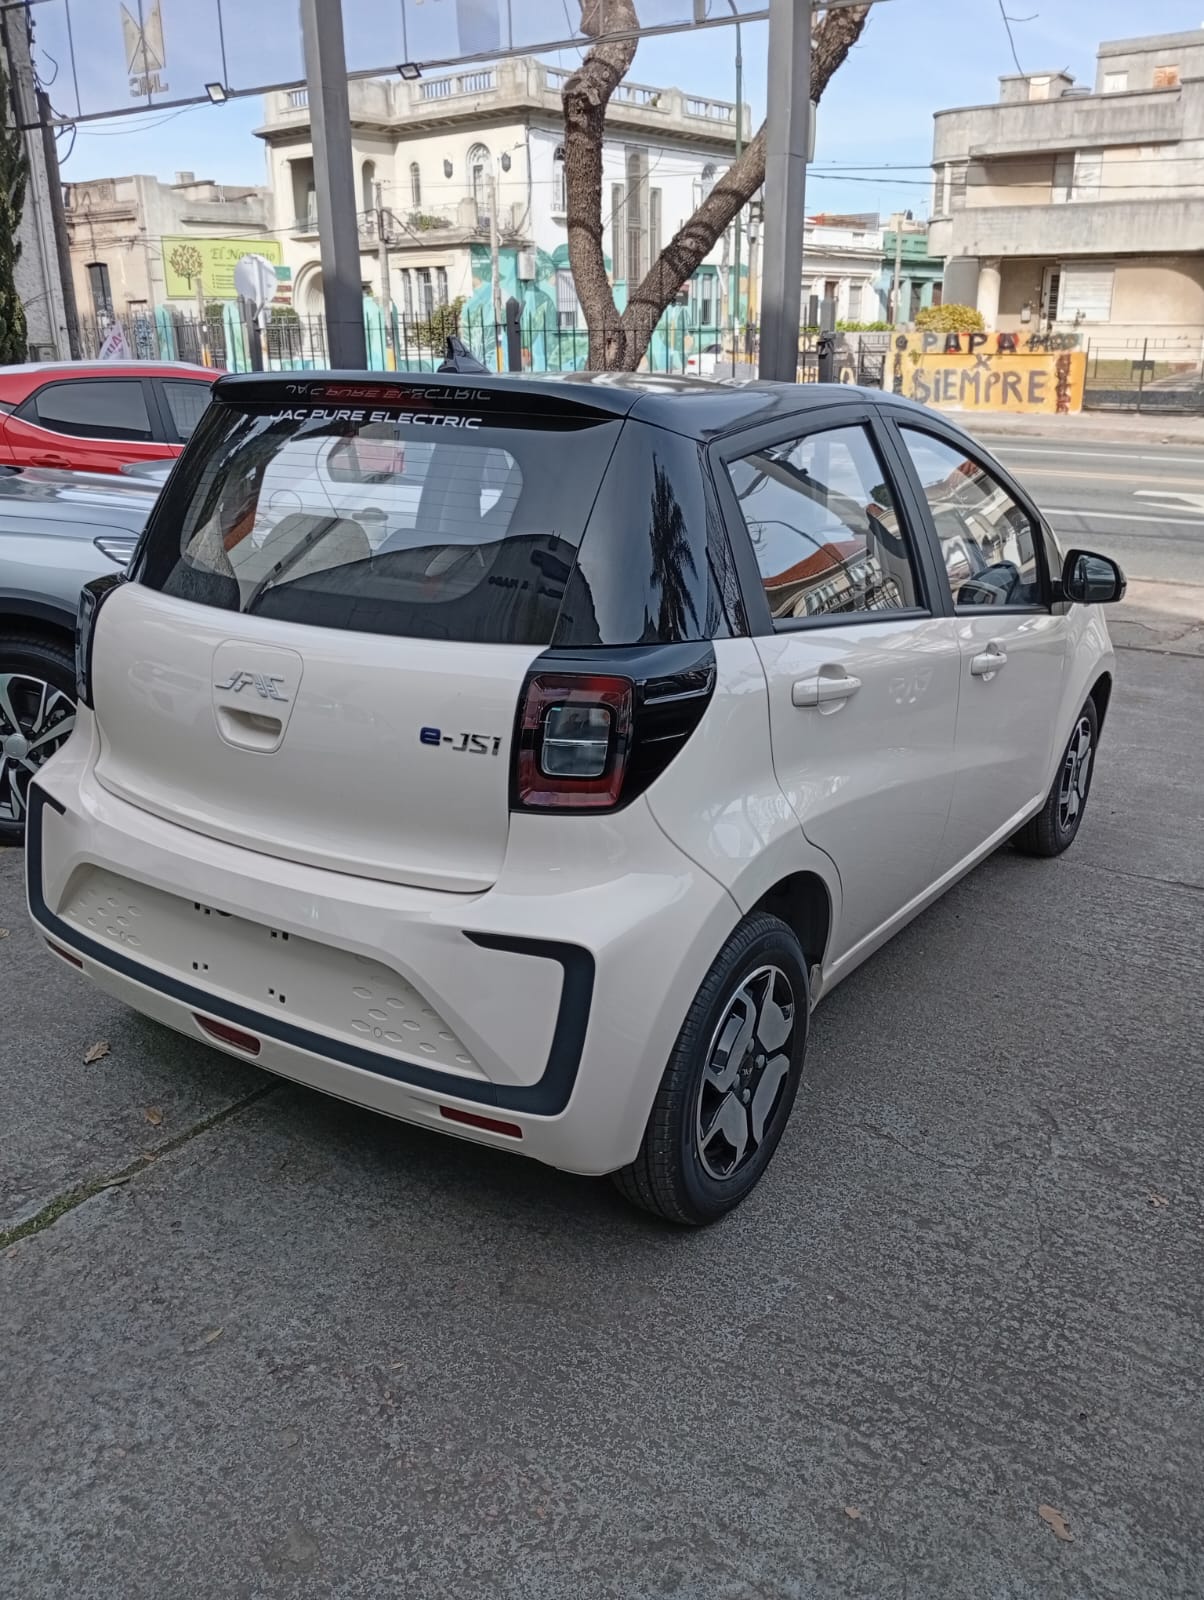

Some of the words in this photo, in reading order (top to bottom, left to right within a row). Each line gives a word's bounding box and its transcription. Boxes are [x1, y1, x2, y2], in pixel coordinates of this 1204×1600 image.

[922, 332, 1017, 354] PAPA
[270, 409, 305, 421] JAC
[309, 410, 364, 422] PURE
[370, 411, 483, 430] ELECTRIC
